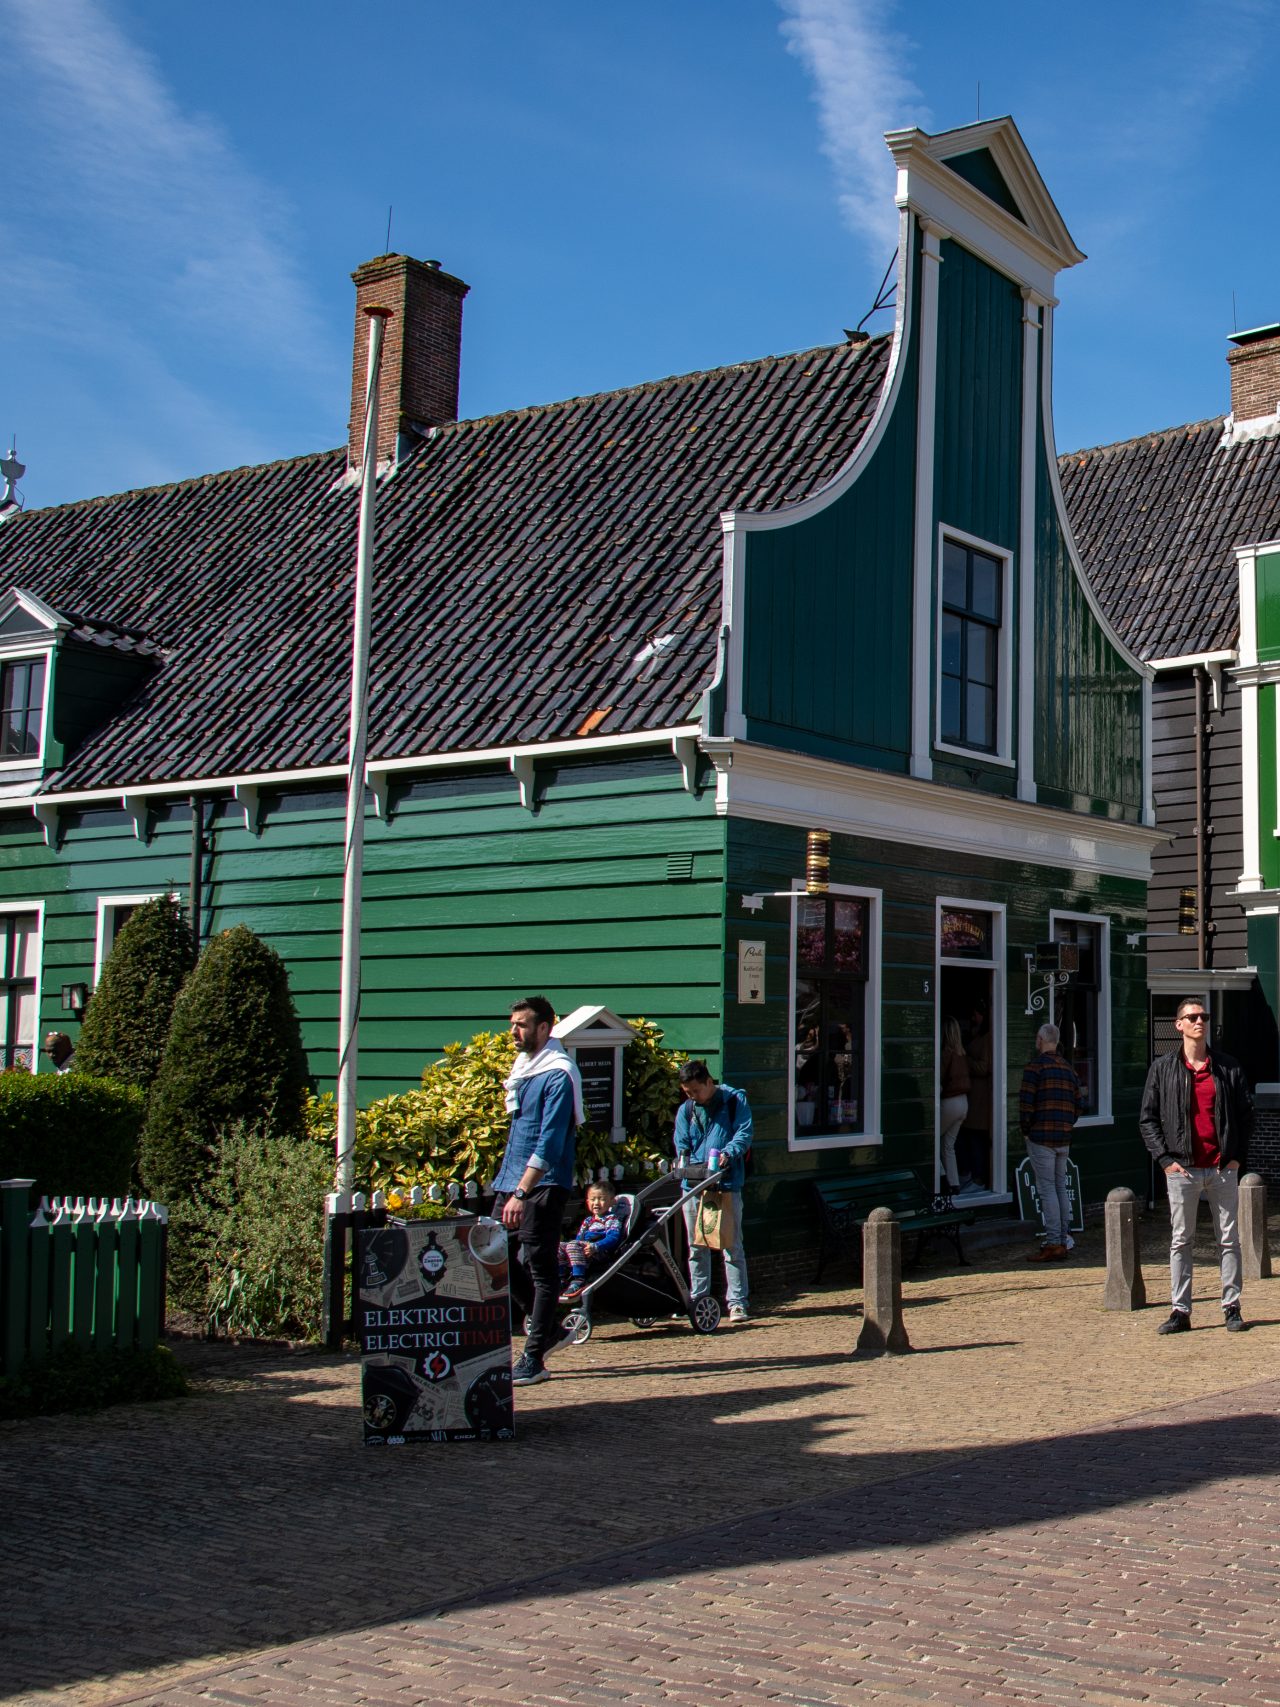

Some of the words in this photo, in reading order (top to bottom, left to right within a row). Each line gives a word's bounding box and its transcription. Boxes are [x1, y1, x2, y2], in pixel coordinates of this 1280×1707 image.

[924, 981, 929, 993] 5
[364, 1305, 505, 1327] ELEKTRICITIJD
[365, 1329, 505, 1351] ELECTRICITIME
